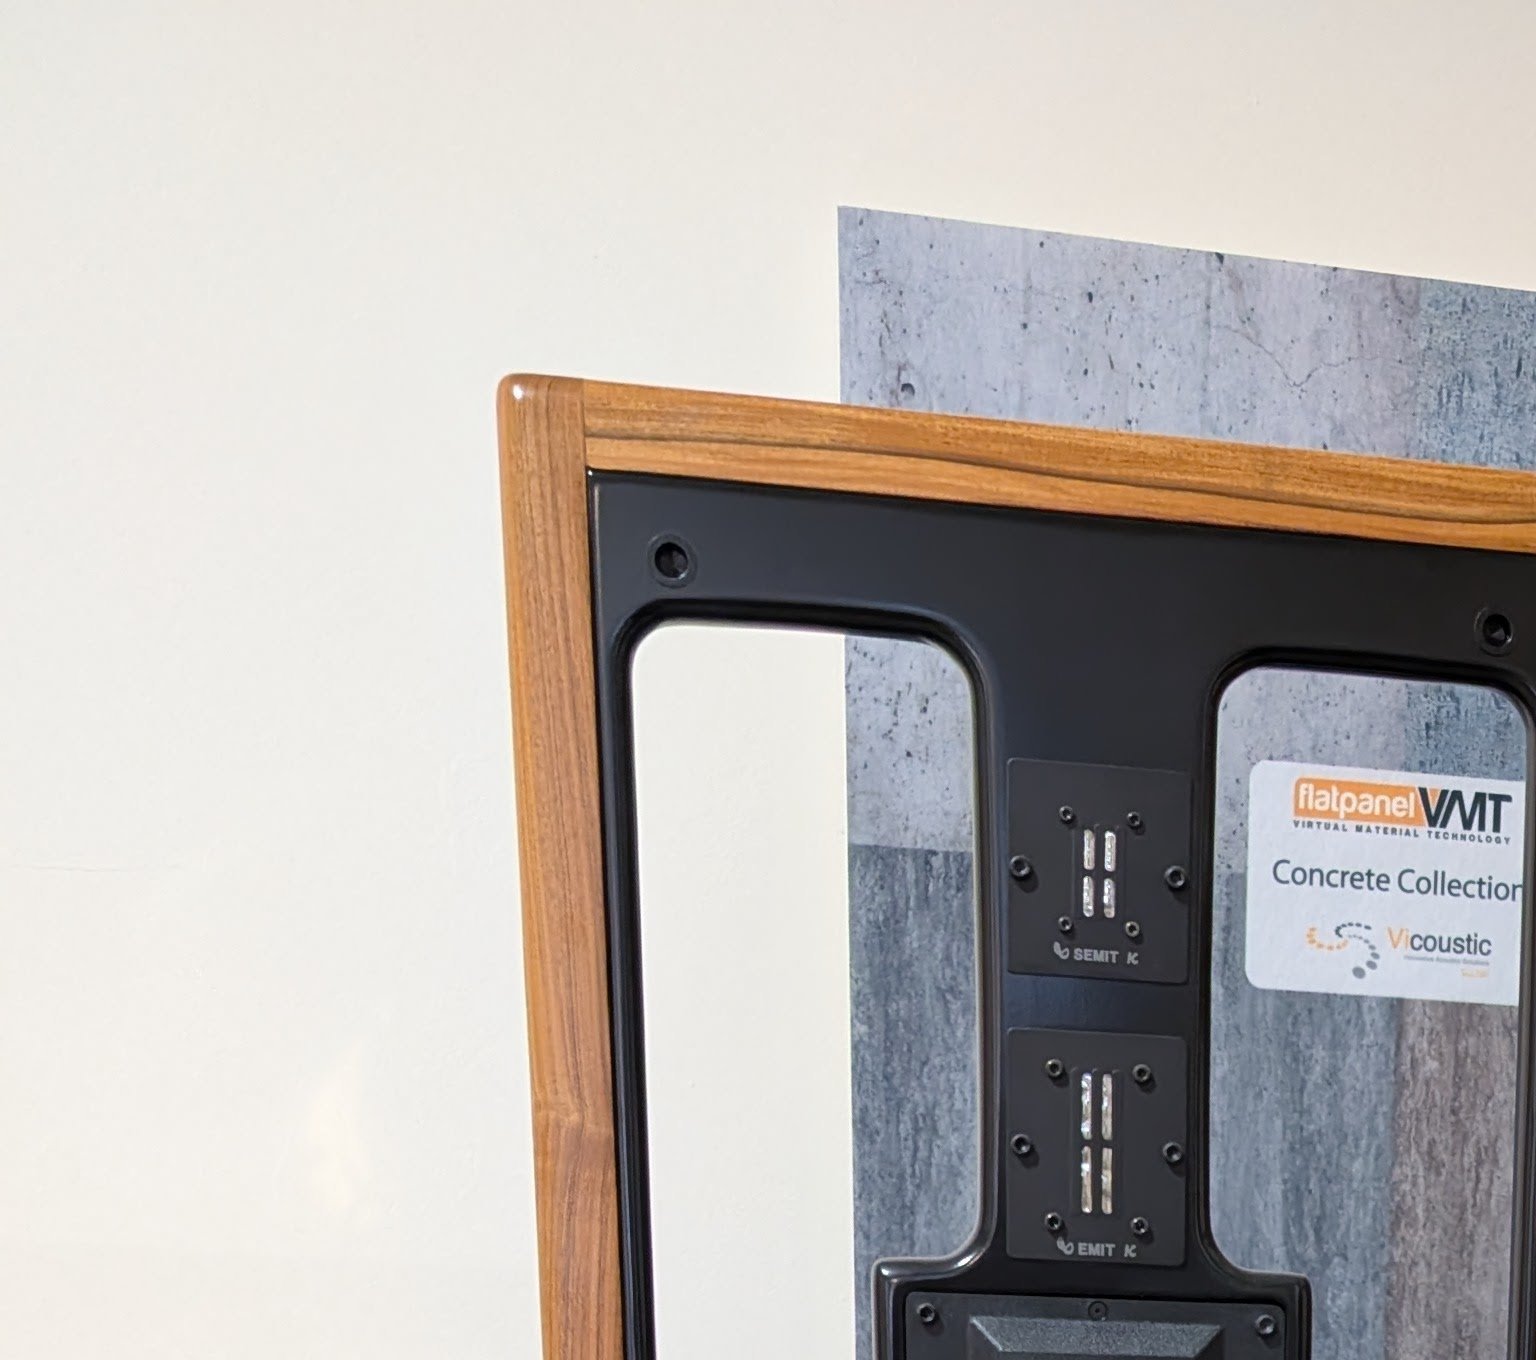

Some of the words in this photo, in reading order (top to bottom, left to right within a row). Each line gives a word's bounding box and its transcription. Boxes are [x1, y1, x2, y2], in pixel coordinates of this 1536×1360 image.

[1298, 783, 1416, 819] flatpanel
[1418, 787, 1513, 833] VMT
[1293, 820, 1348, 832] VIRTUAL
[1355, 825, 1419, 838] MATERIAL
[1427, 831, 1511, 845] TECHNOLOGY
[1272, 859, 1391, 892] Concrete
[1387, 926, 1492, 956] Vicoustic
[1074, 947, 1119, 963] SEMIT
[1078, 1242, 1116, 1257] EMIT
